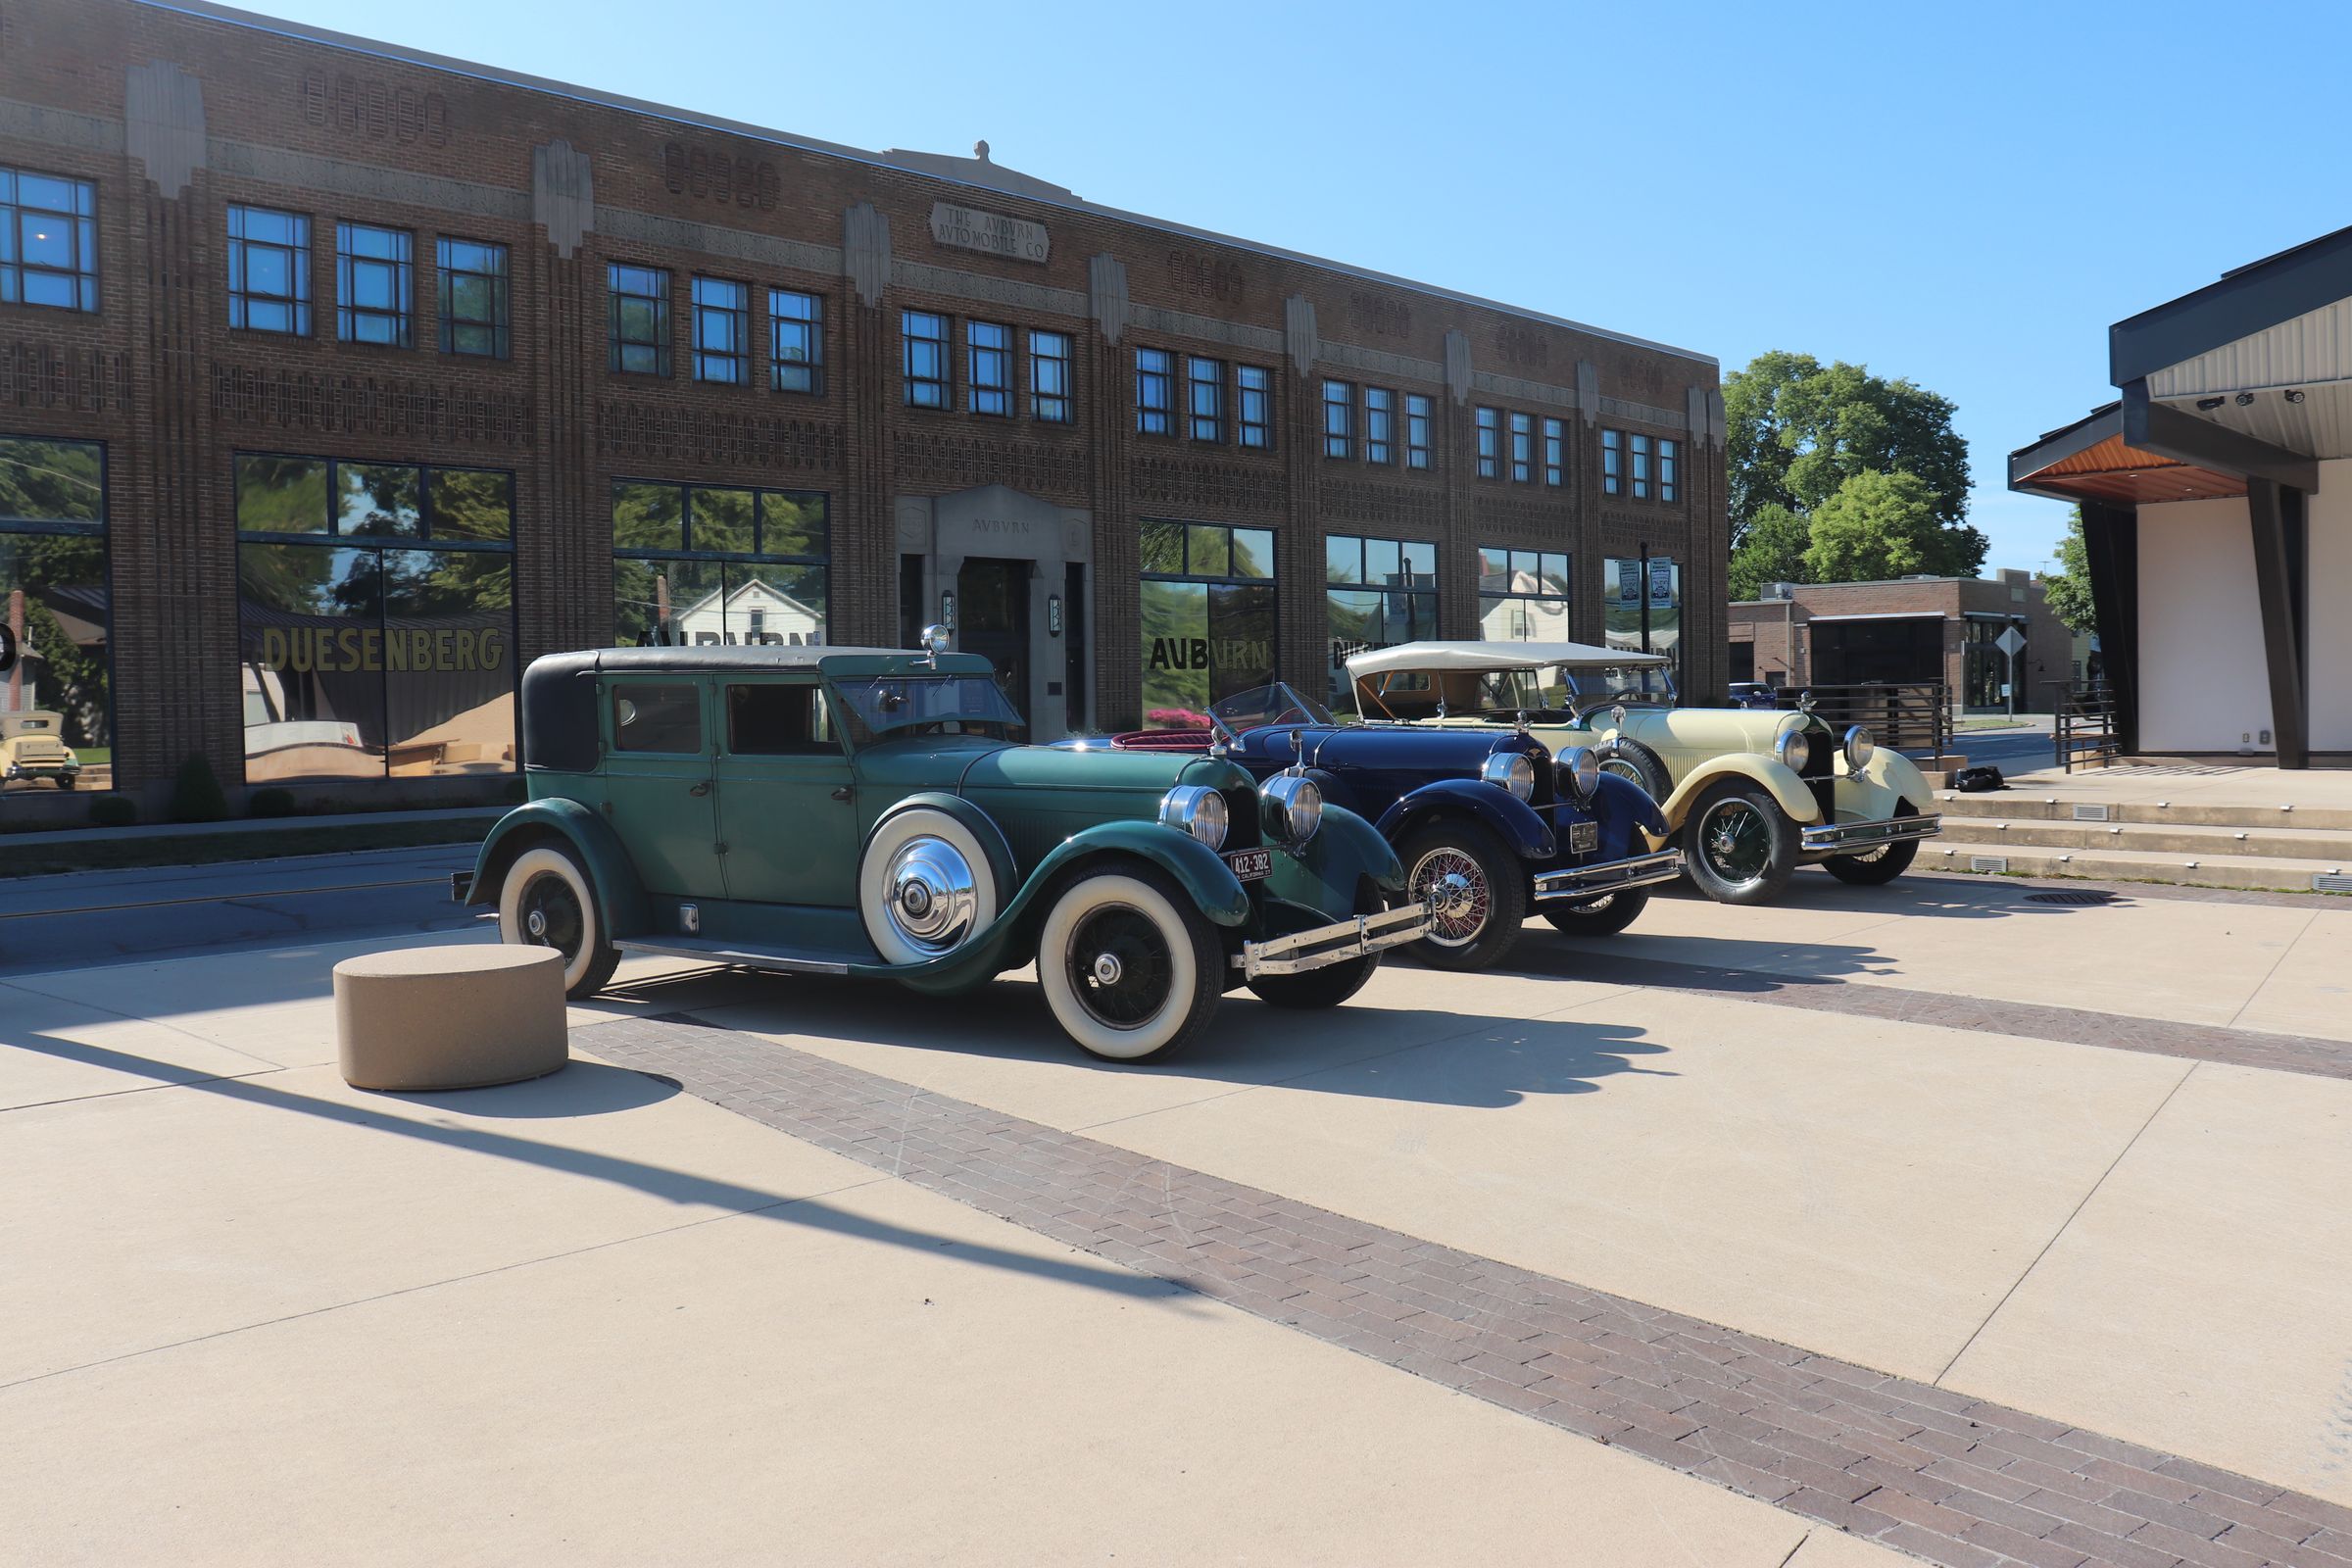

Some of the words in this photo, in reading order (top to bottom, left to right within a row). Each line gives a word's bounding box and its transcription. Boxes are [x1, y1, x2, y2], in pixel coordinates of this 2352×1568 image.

[946, 208, 971, 226] THE
[1025, 242, 1045, 258] CO
[264, 627, 503, 671] DUESENBERG
[1149, 637, 1268, 670] AUBURN
